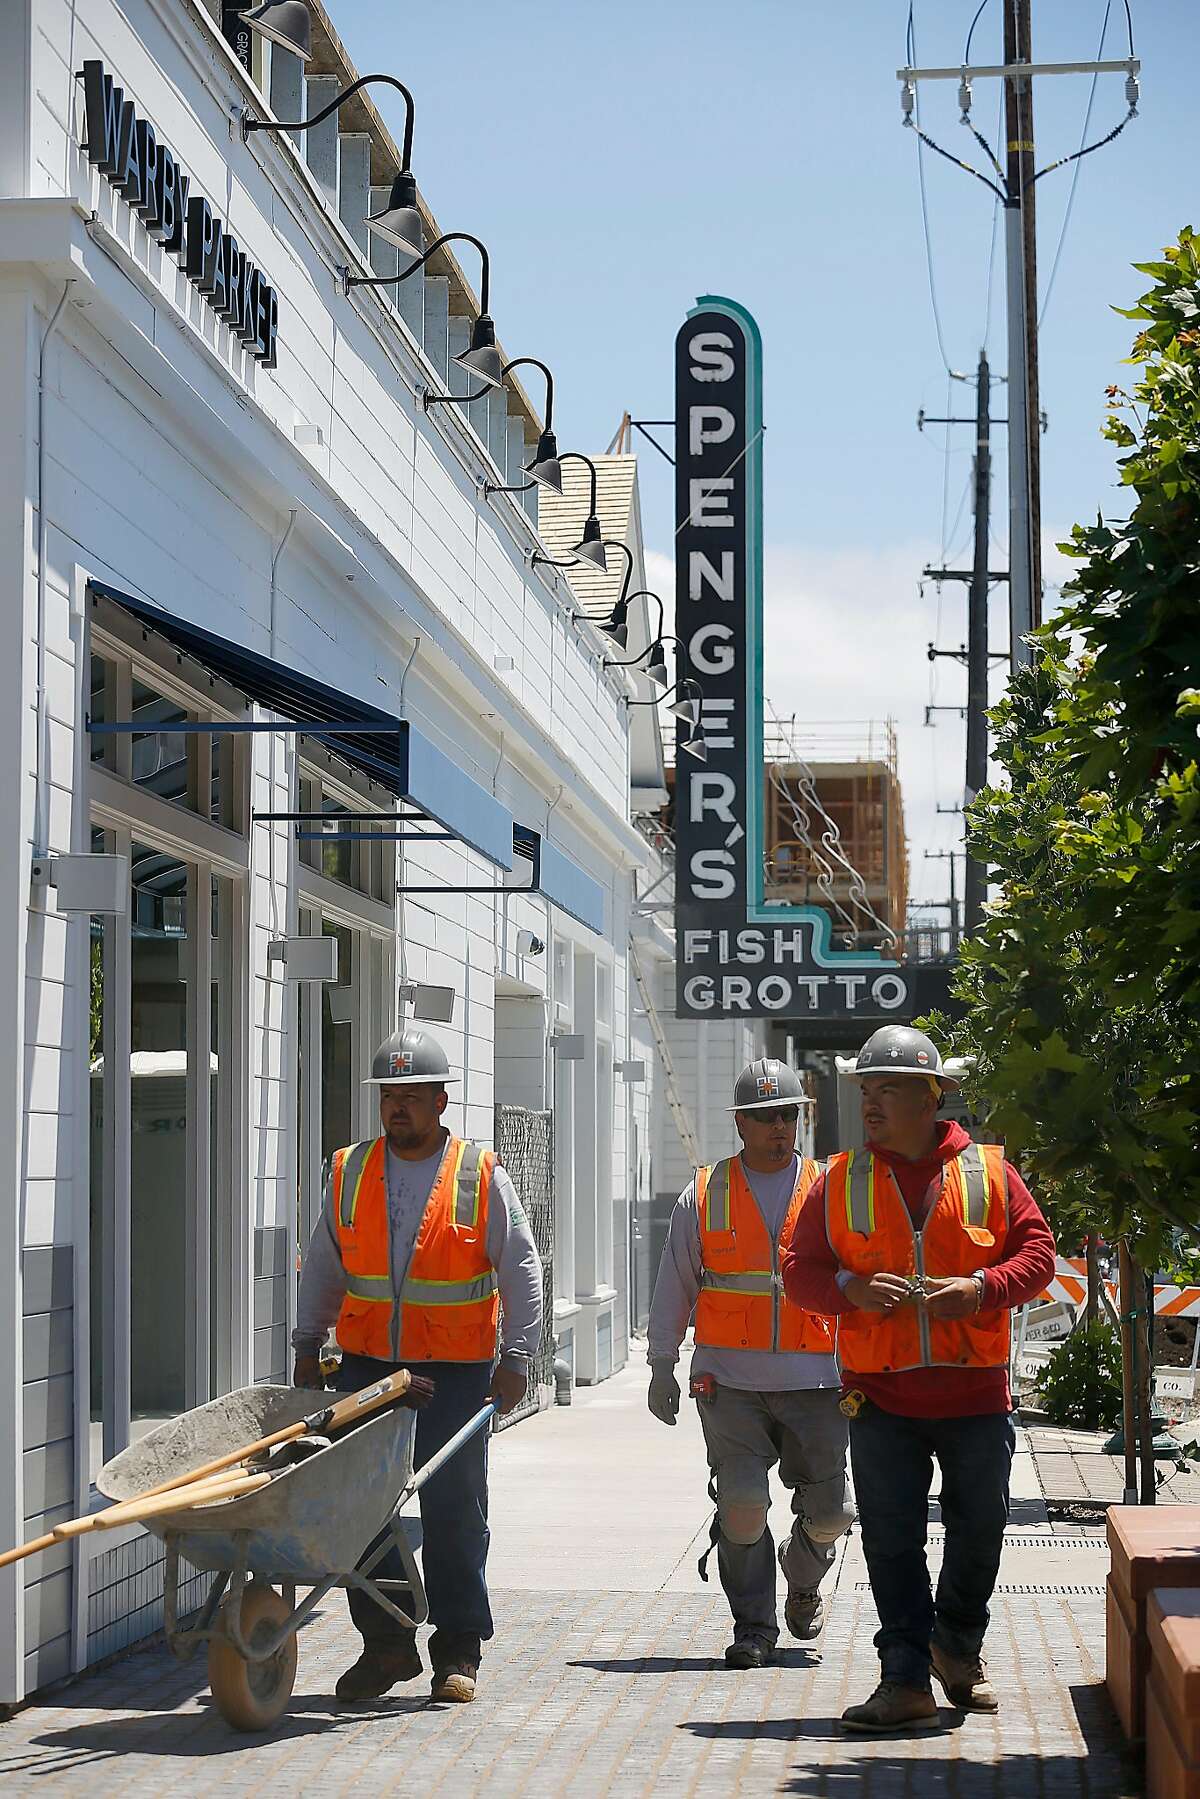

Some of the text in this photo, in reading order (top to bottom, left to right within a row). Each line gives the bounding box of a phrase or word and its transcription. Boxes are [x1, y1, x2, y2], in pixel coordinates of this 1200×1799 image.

[236, 31, 249, 71] GRAC
[83, 60, 278, 369] WARBY PARKER
[688, 331, 745, 900] SPENGER'S
[684, 929, 802, 964] FISH
[683, 974, 908, 1010] GROTTO
